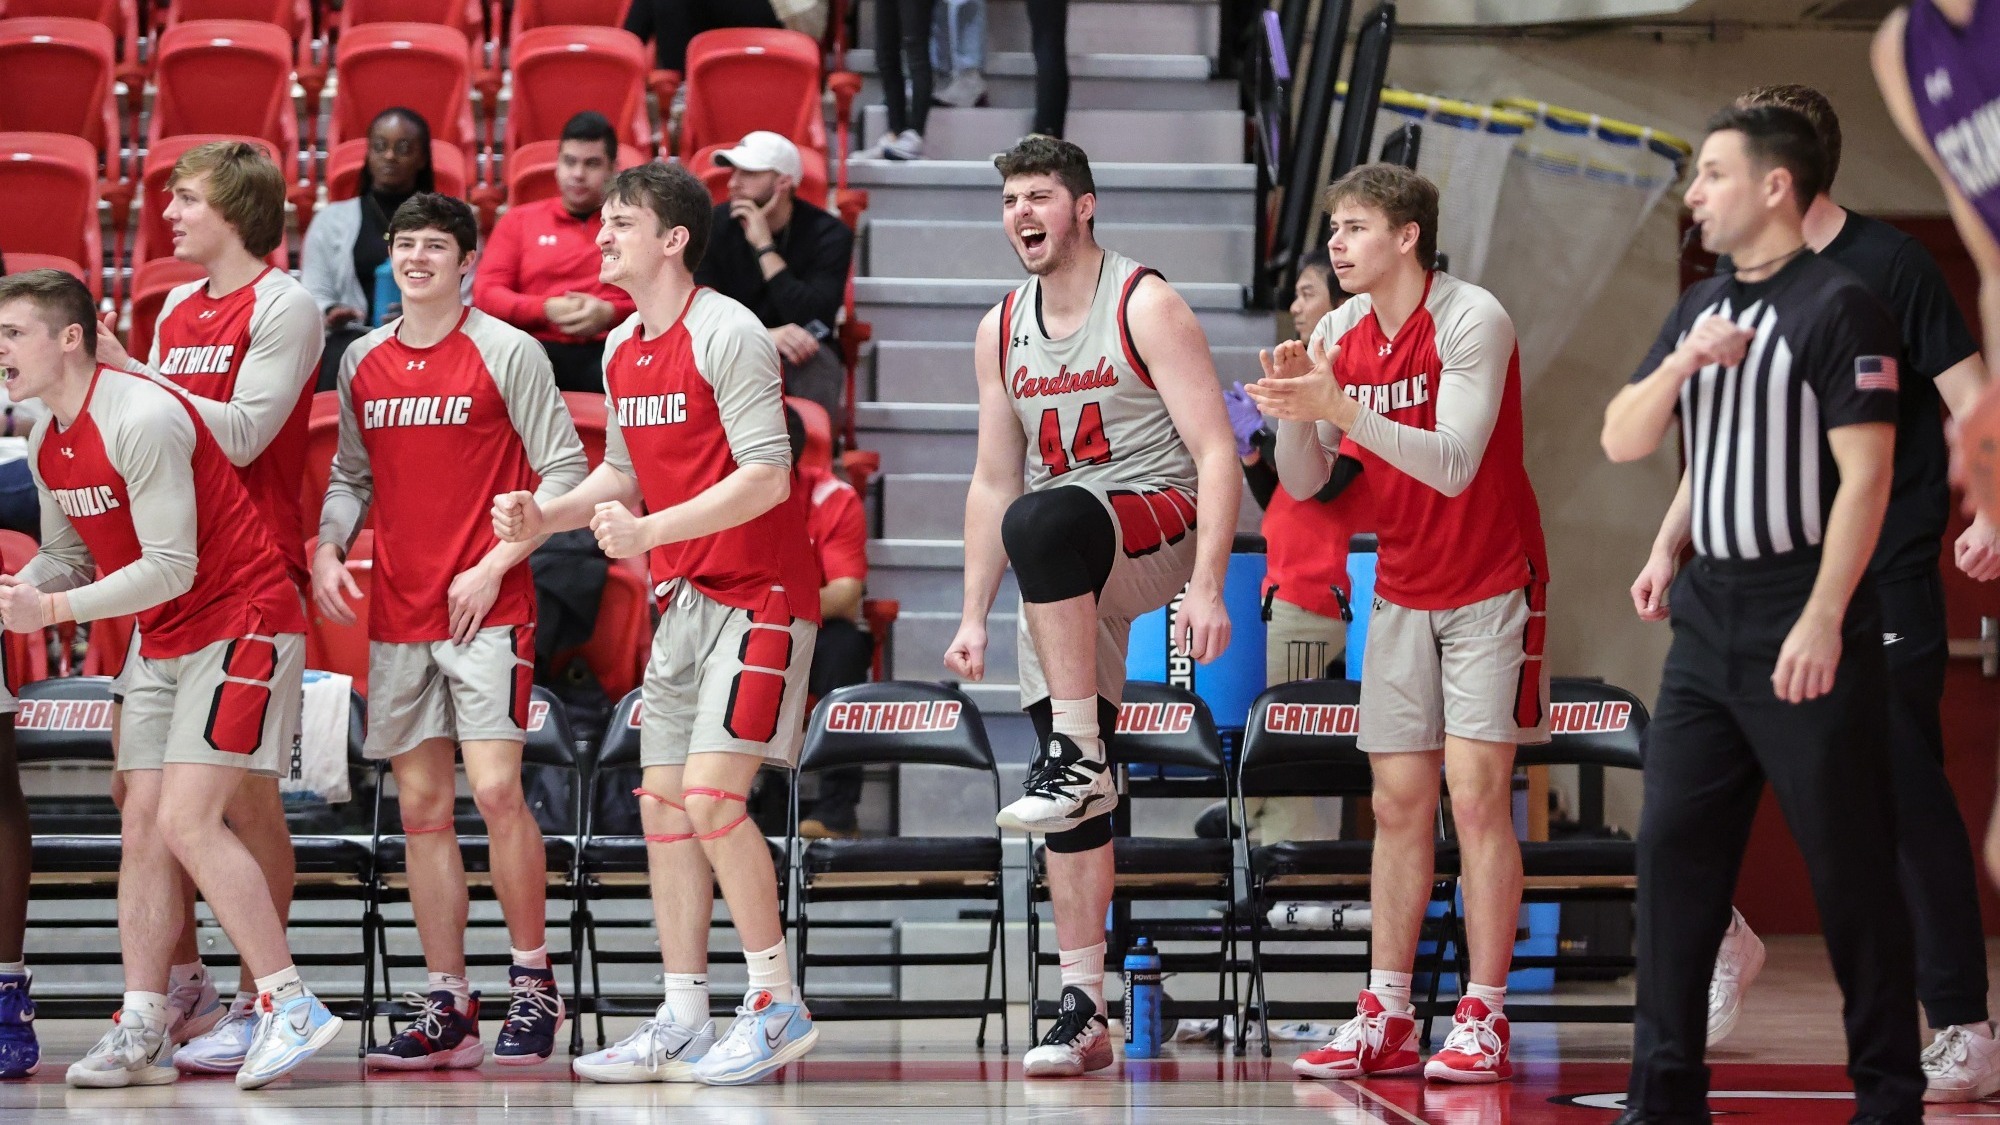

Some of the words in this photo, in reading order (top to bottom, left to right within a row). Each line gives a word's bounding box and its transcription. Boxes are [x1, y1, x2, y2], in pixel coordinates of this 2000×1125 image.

[1012, 356, 1119, 399] Cardinals
[363, 395, 473, 430] CATHOLIC
[1038, 401, 1112, 476] 44
[50, 485, 121, 518] ATHOLIC
[14, 699, 115, 731] CATHO
[825, 700, 963, 733] CATHOLIC
[1115, 702, 1196, 735] HOLIC
[1265, 702, 1360, 736] CATHO
[1550, 701, 1632, 734] HOLIC
[1124, 970, 1132, 1041] POWERADE
